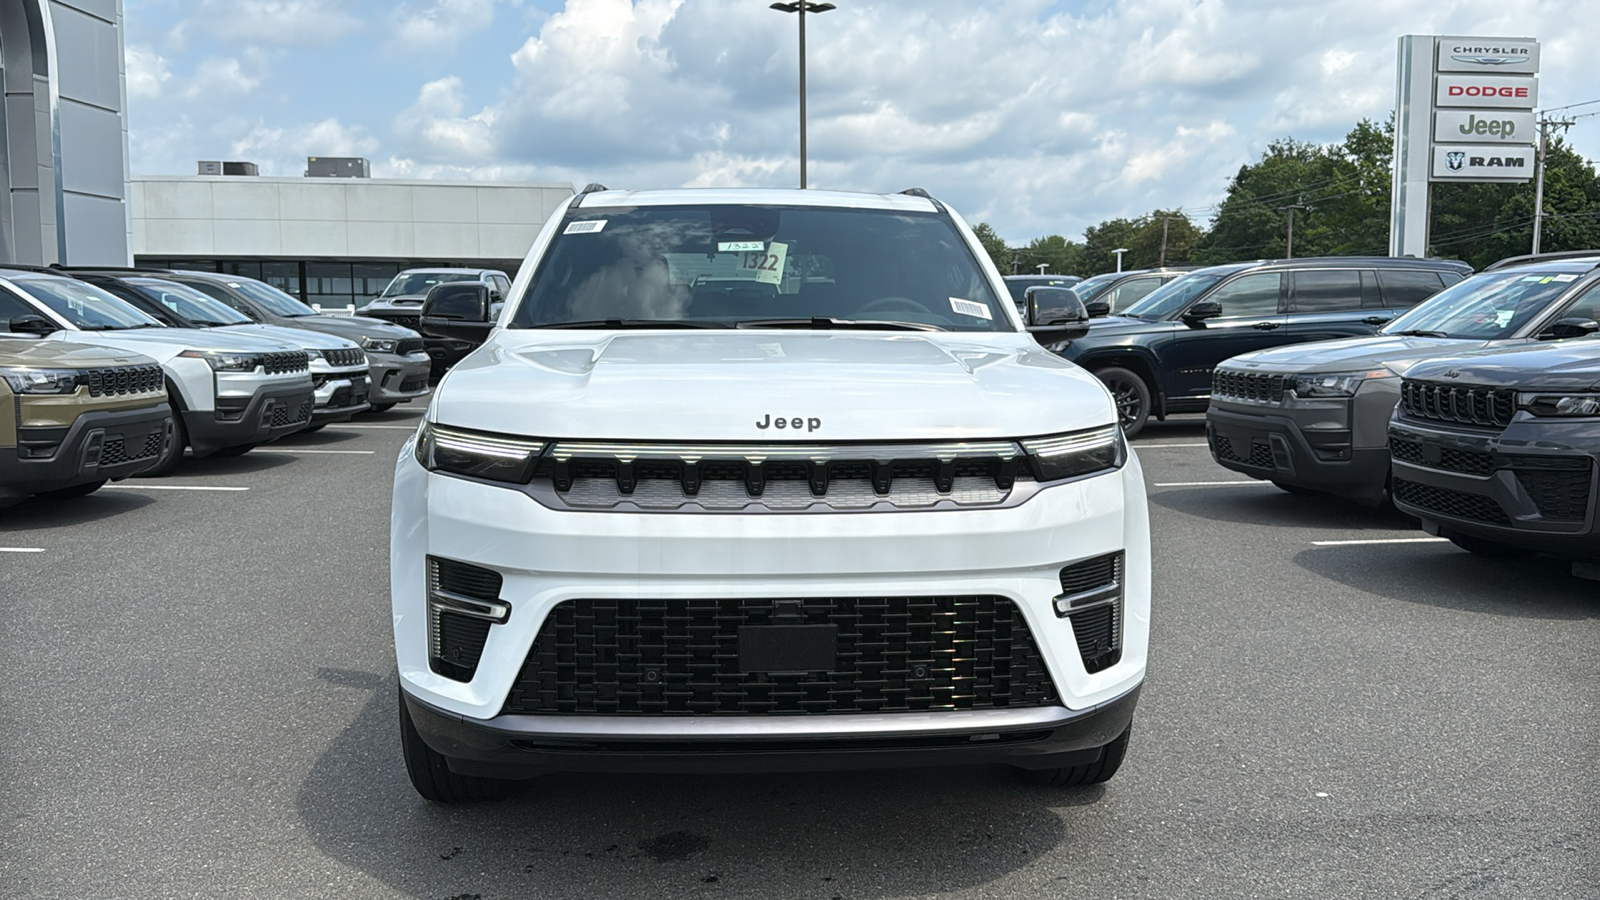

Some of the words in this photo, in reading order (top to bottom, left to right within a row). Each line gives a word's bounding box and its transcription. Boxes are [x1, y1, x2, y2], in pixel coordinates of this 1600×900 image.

[1453, 46, 1528, 54] CHRYSLER
[1449, 86, 1528, 97] DODGE
[1459, 114, 1515, 139] Jeep
[1469, 157, 1524, 167] RAM
[742, 252, 778, 271] 1322
[756, 414, 821, 432] Jeep
